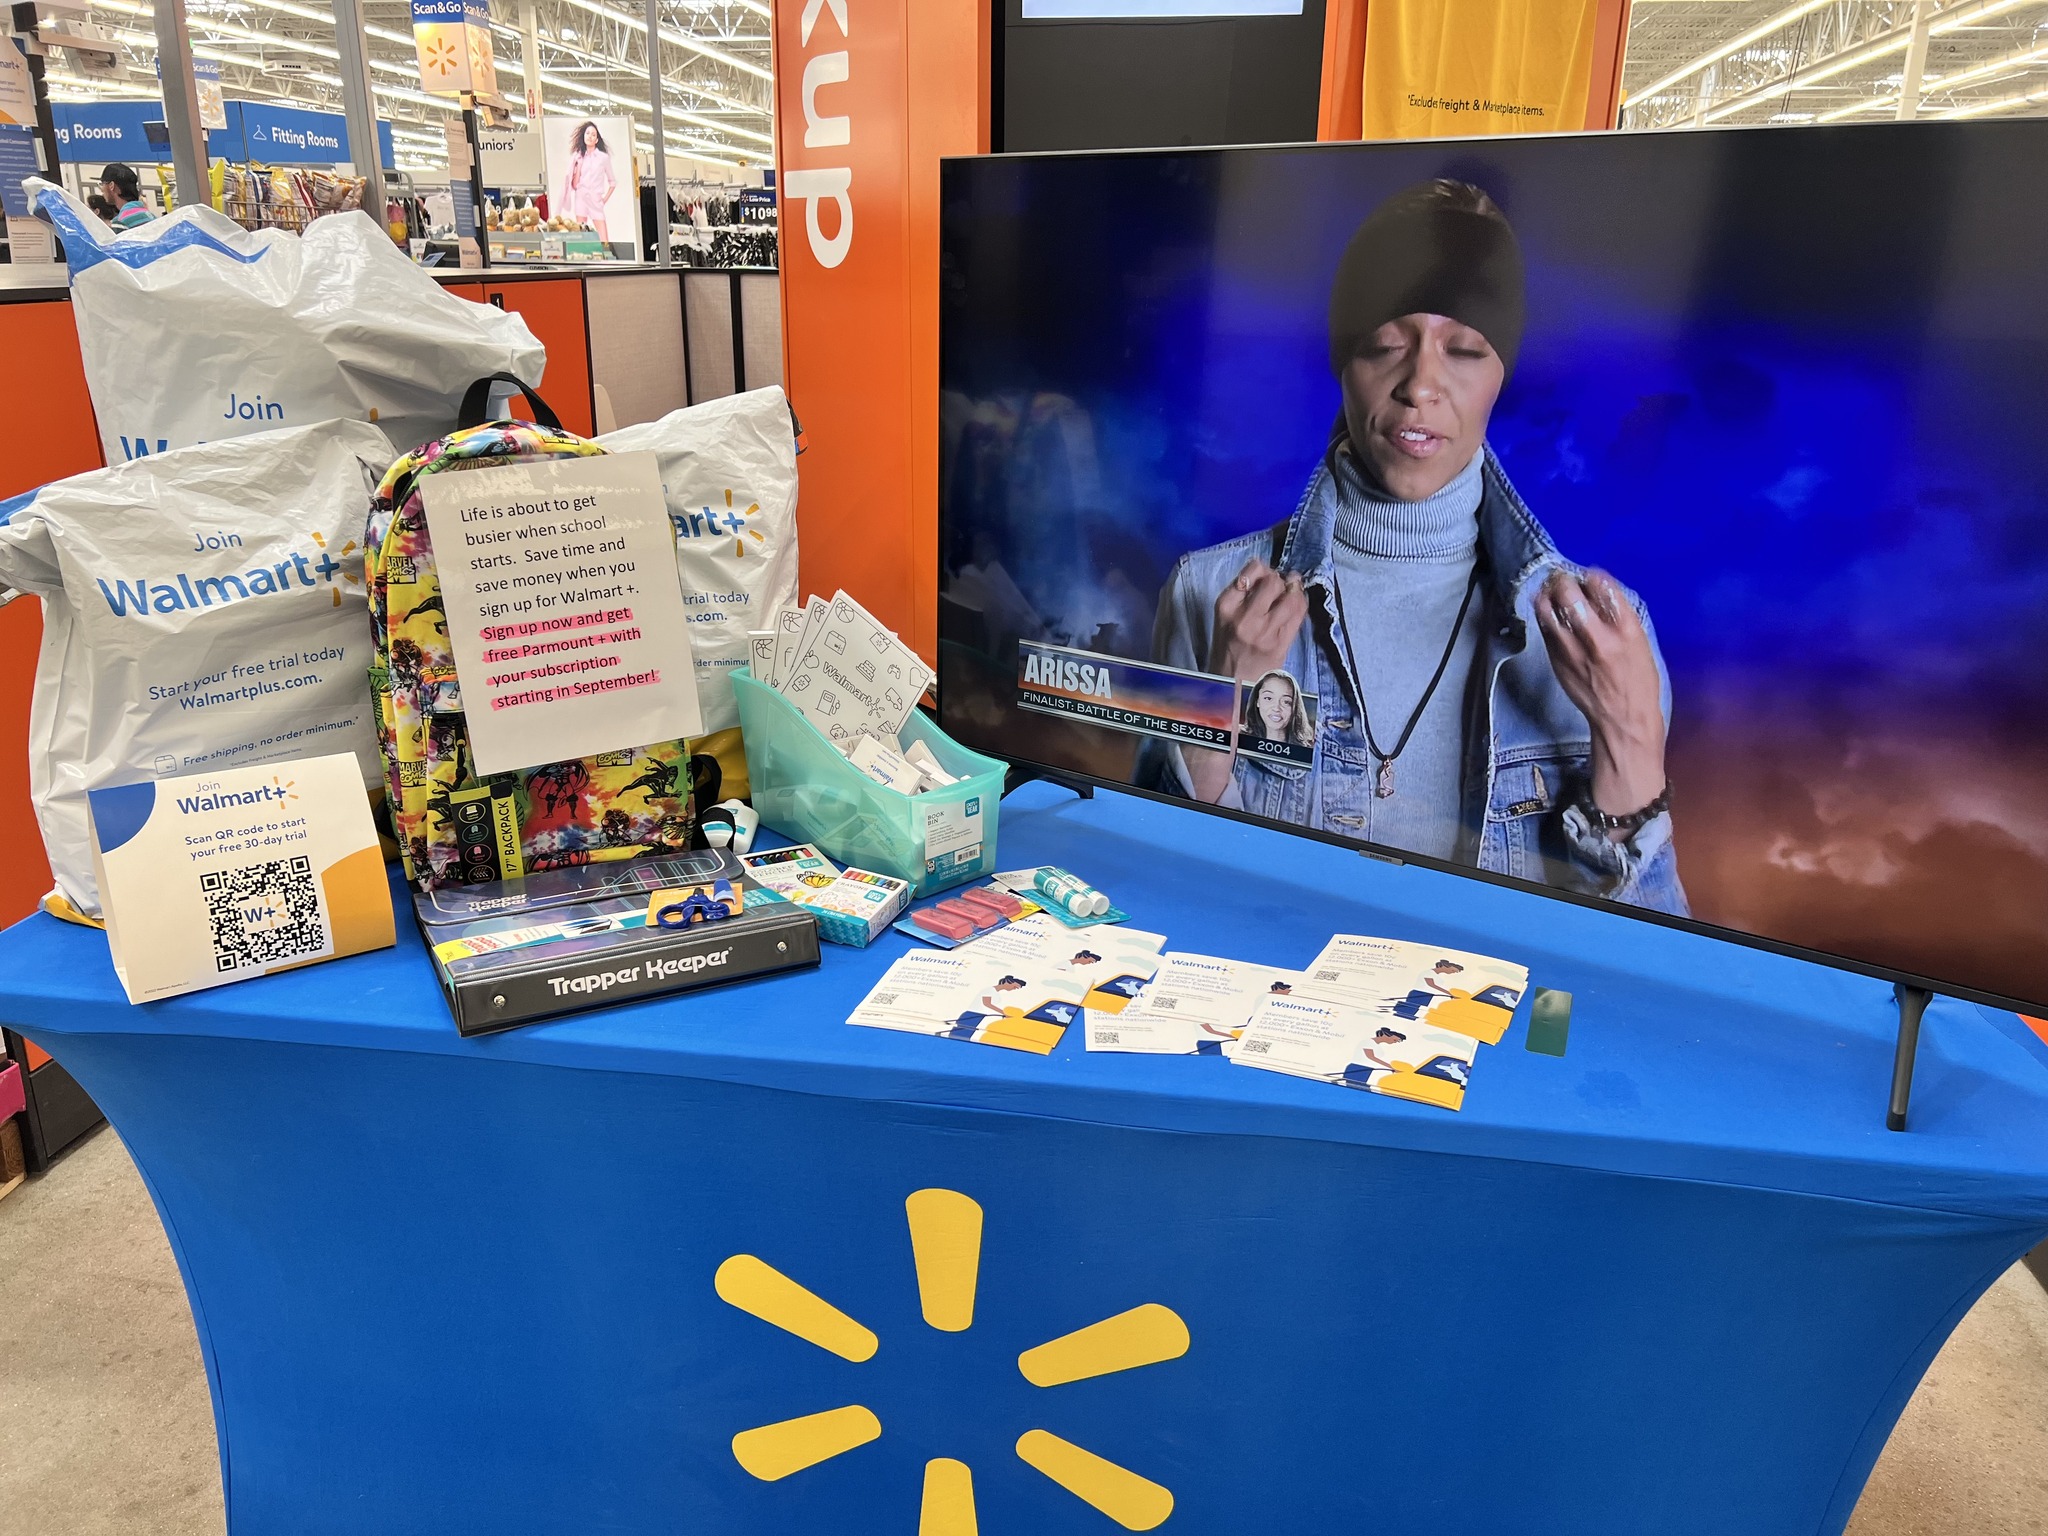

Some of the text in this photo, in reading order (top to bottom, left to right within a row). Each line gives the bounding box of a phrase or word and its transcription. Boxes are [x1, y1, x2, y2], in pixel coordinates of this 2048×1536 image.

[413, 2, 461, 14] Scan&Go
[1439, 98, 1470, 113] freight
[1473, 99, 1480, 110] &
[1482, 100, 1520, 116] Marketplace
[1521, 104, 1545, 116] items.
[74, 122, 122, 139] Rooms
[271, 126, 338, 149] Fitting Rooms
[478, 139, 515, 151] uniors'
[223, 394, 284, 421] Join
[461, 495, 597, 522] Life is about to get
[194, 530, 242, 551] Join
[465, 516, 607, 545] busier when school
[470, 537, 625, 570] starts. Save time and
[96, 552, 340, 617] Walmart+
[475, 561, 636, 593] save money when you
[479, 584, 640, 618] sign up for Walmart +.
[683, 592, 749, 605] trial today
[483, 607, 631, 641] Sign up now and get
[488, 628, 641, 663] free Parmount + with
[148, 647, 345, 702] Start your free trial today
[492, 655, 618, 687] your subscription
[1024, 653, 1112, 699] ARISSA
[180, 674, 323, 711] Walmartplus.com.
[497, 669, 656, 708] starting in September!
[1023, 692, 1225, 743] FINALIST: BATTLE OF THE SEXES 2
[183, 755, 208, 767] Free
[211, 742, 258, 760] shipping,
[260, 736, 273, 746] no
[275, 729, 303, 742] order
[1257, 740, 1291, 757] 2004
[177, 785, 286, 815] Walmart+
[196, 781, 221, 793] Join
[498, 801, 515, 855] BACKPACK
[928, 811, 944, 820] BOOK
[185, 817, 307, 846] Scan QR code to start
[191, 830, 307, 861] your free 30-day trial
[1003, 926, 1044, 938] almart+
[1338, 940, 1394, 950] Walmart+
[910, 955, 964, 967] Walmart+
[1171, 959, 1228, 972] Walmart+
[547, 965, 640, 996] Trapper
[1271, 1001, 1331, 1015] Walmart+
